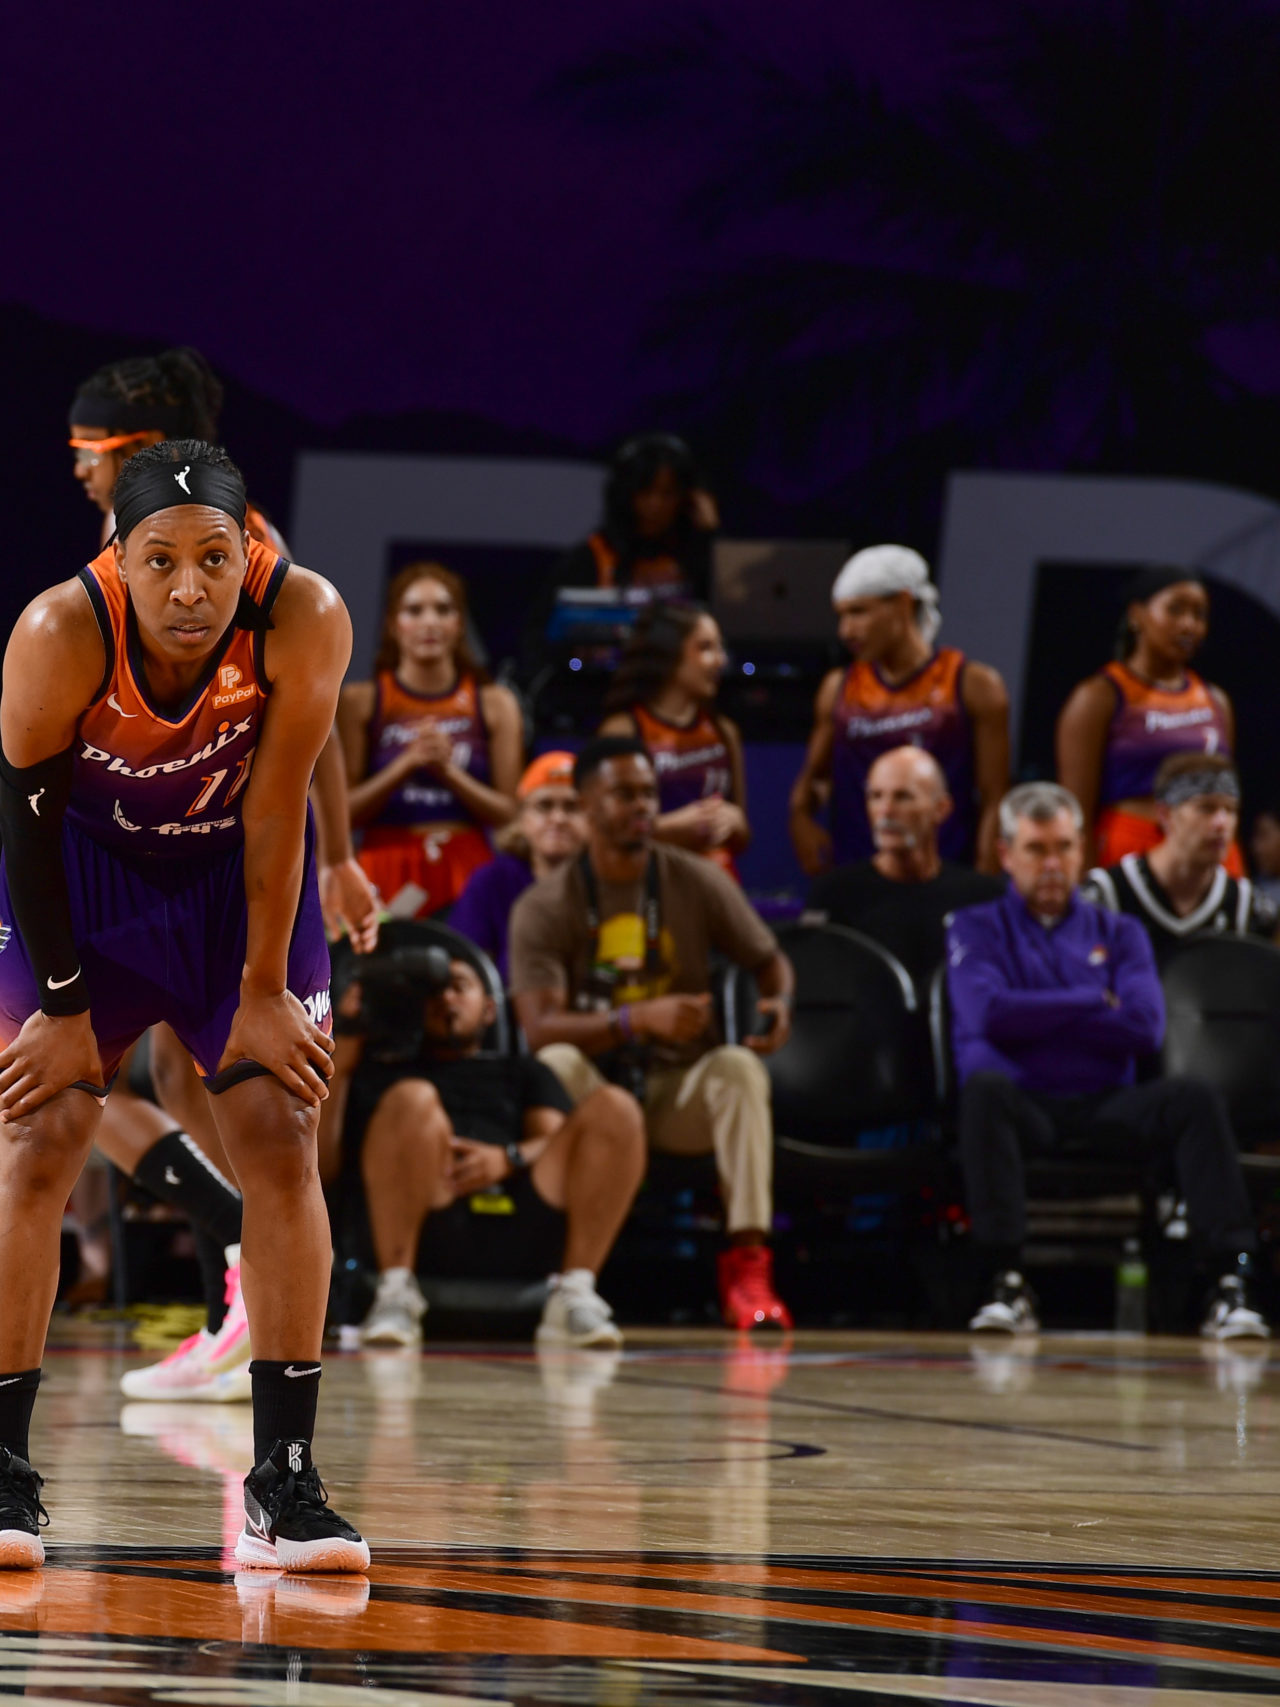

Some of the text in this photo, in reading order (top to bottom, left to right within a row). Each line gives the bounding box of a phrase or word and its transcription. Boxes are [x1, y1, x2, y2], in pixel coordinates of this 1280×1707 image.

[214, 684, 255, 707] PayPal
[81, 714, 253, 779] Phoenix
[184, 746, 256, 817] 11
